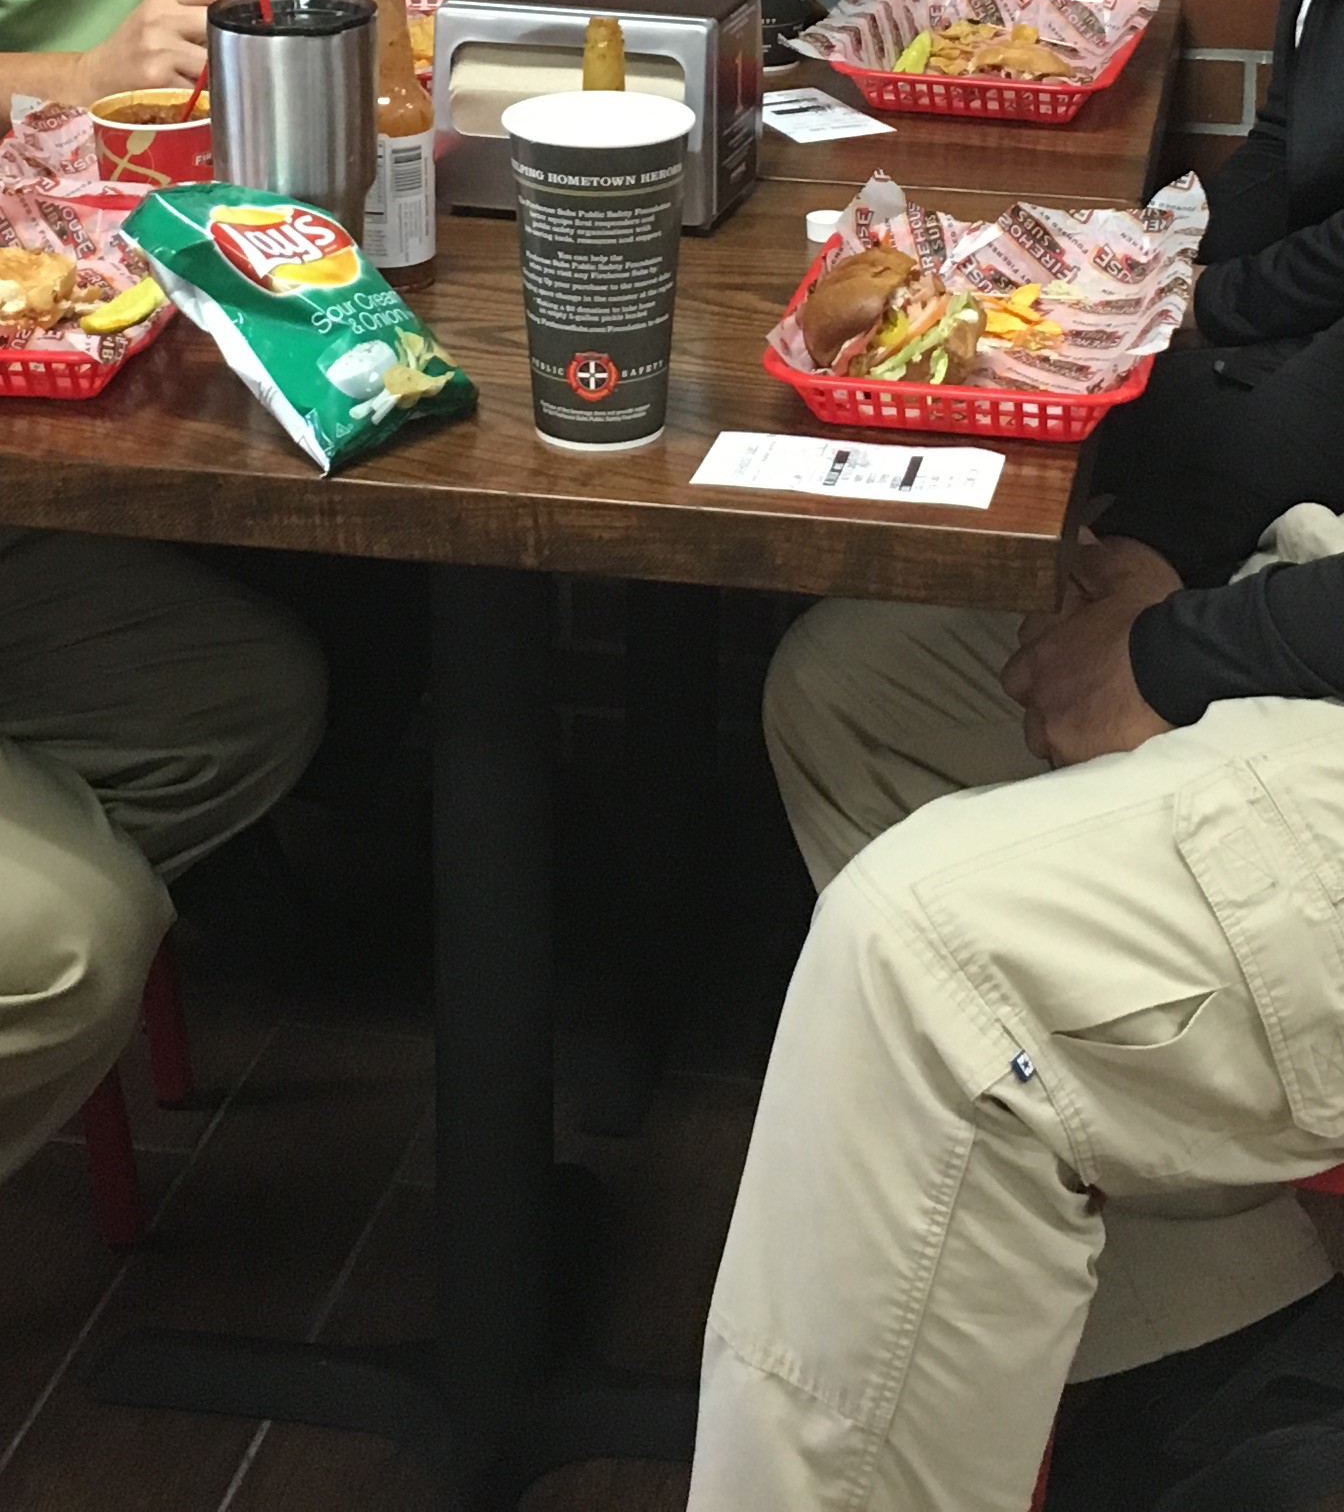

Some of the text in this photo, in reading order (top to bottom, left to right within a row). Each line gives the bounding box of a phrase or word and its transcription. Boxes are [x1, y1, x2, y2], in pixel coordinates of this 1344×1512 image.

[548, 172, 637, 186] HOMETOWN
[217, 214, 336, 279] Lay's
[996, 212, 1082, 284] FIREHO
[1017, 209, 1053, 247] SUBS
[311, 290, 399, 335] Sour Crea
[348, 308, 410, 335] & Onion
